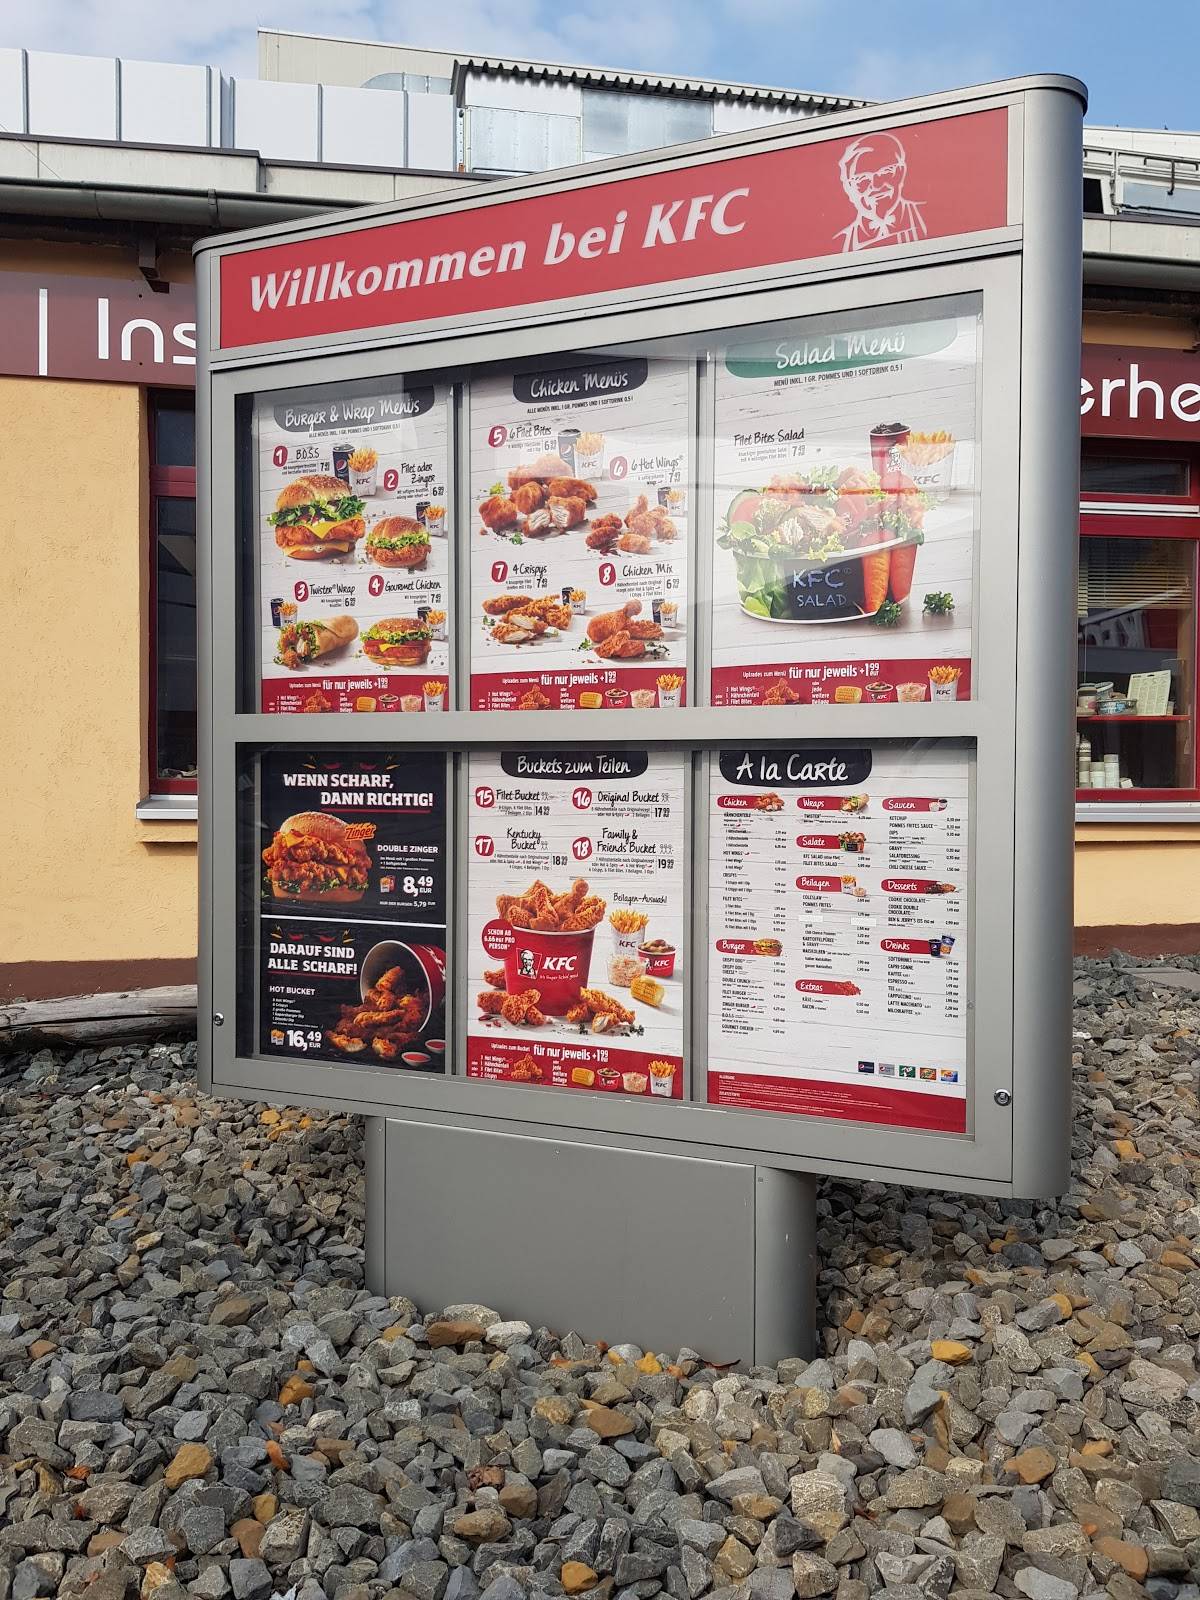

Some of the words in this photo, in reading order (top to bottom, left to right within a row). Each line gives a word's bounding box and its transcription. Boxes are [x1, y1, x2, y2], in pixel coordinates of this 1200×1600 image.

[250, 238, 527, 313] Willkommen
[543, 208, 627, 267] bei
[641, 188, 749, 248] KFC
[776, 341, 836, 370] Salad
[846, 331, 906, 359] Menü
[774, 377, 789, 387] MENÜ
[818, 371, 841, 382] POMMES
[842, 369, 854, 379] UND
[858, 365, 889, 377] SOFTDRINK
[530, 377, 579, 398] Chicken
[582, 370, 629, 388] Menüs
[285, 409, 326, 431] Burger
[329, 405, 339, 422] &
[342, 400, 375, 423] Wrap
[379, 398, 420, 416] Menüs
[734, 434, 752, 446] Filet
[754, 431, 775, 444] Bites
[777, 428, 805, 443] Salad
[638, 457, 654, 471] Hot
[519, 563, 548, 577] Crispys
[622, 564, 653, 577] Chicken
[655, 563, 673, 574] Mix
[385, 580, 414, 592] Gourmet
[416, 578, 442, 590] Chicken
[793, 568, 844, 589] KFC
[796, 594, 847, 608] SALAD
[541, 673, 553, 687] für
[554, 675, 568, 686] nur
[568, 672, 598, 688] jeweils
[789, 667, 803, 680] für
[805, 668, 822, 679] nur
[824, 665, 858, 682] jeweils
[335, 680, 346, 690] nur
[347, 679, 373, 692] jeweils
[517, 755, 563, 775] Buckets
[564, 762, 593, 775] zum
[596, 754, 632, 774] Teilen
[736, 752, 754, 781] A
[760, 755, 782, 781] la
[786, 753, 849, 781] Carte
[283, 773, 329, 788] WENN
[330, 773, 394, 790] SCHARF,
[320, 792, 365, 806] DANN
[366, 792, 434, 807] RICHTIG!
[496, 789, 514, 801] Filet
[514, 789, 541, 801] Bucket
[597, 791, 630, 807] Original
[633, 792, 659, 803] Bucket
[723, 797, 748, 807] Chicken
[802, 798, 825, 810] Wraps
[888, 799, 916, 810] Saucen
[345, 825, 375, 841] Zinger
[506, 827, 541, 845] Kentucky
[602, 827, 631, 845] Family
[631, 829, 639, 840] &
[511, 838, 536, 850] Bucket
[597, 840, 626, 853] Friends
[629, 841, 657, 854] Bucket
[802, 836, 826, 846] Salate
[377, 844, 408, 853] DOUBLE
[409, 845, 439, 854] ZINGER
[801, 876, 831, 891] Beilagen
[887, 880, 917, 891] Desserts
[270, 942, 322, 958] DARAUF
[324, 945, 355, 960] SIND
[618, 939, 637, 949] KFC
[722, 940, 746, 954] Burger
[885, 939, 910, 951] Drinks
[267, 958, 299, 972] ALLE
[302, 960, 358, 976] SCHARF!
[542, 955, 578, 972] KFC
[653, 959, 670, 968] KFC
[269, 985, 285, 994] HOT
[286, 986, 316, 996] BUCKET
[800, 981, 823, 991] Extras
[533, 1043, 546, 1057] für
[547, 1047, 562, 1058] nur
[562, 1047, 591, 1063] jeweils
